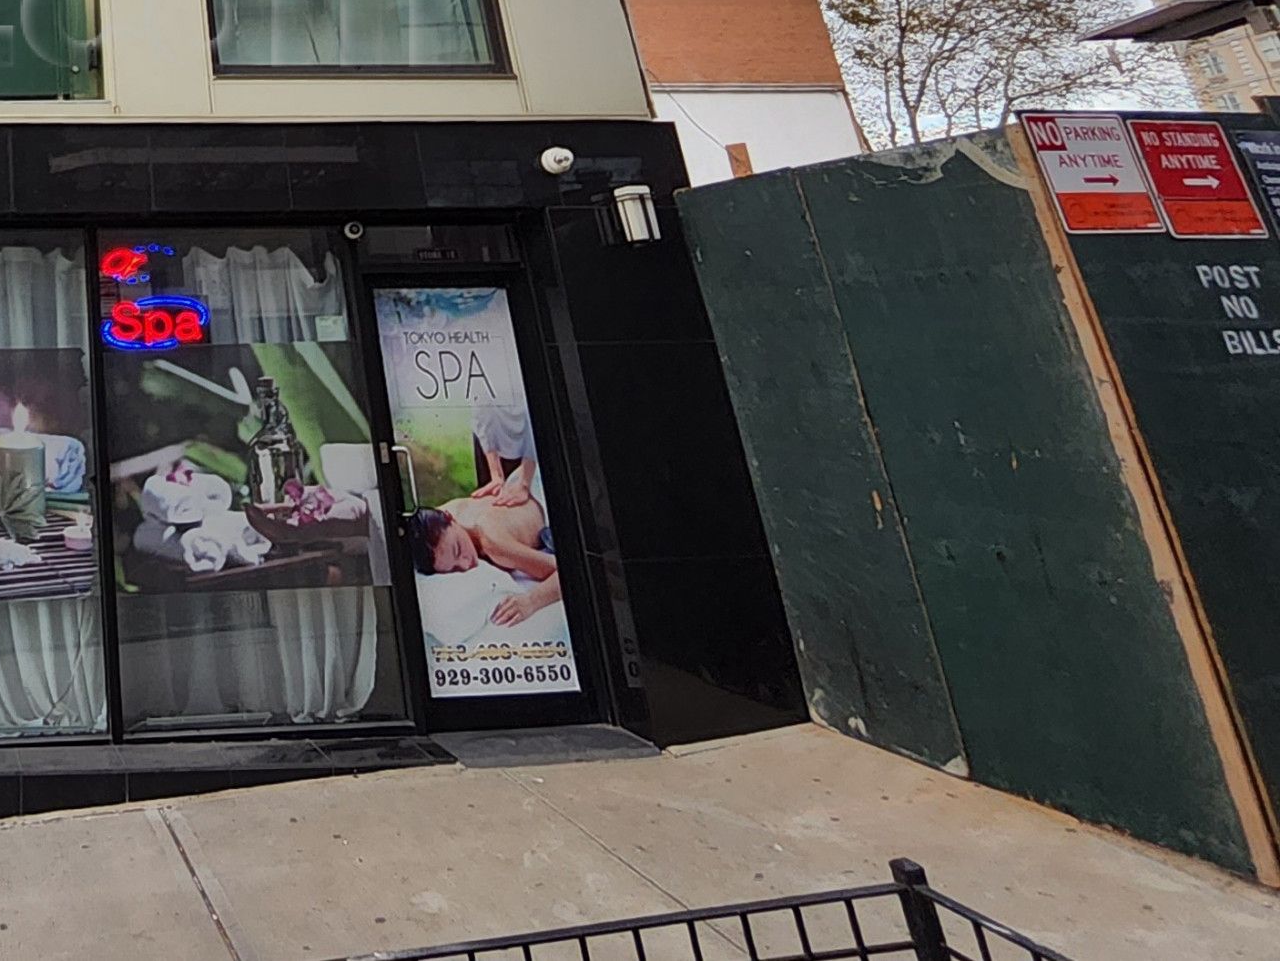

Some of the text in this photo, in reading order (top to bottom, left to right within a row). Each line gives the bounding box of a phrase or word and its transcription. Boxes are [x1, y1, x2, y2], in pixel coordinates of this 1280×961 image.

[1029, 121, 1120, 146] NO PARKING
[1140, 130, 1219, 147] NO STANDING
[1058, 154, 1123, 168] ANYTIME
[1160, 154, 1222, 169] ANYTIME
[1195, 265, 1261, 289] POST
[1220, 295, 1259, 319] NO
[111, 300, 203, 345] Spa
[402, 331, 490, 345] TOKYO HEALTH
[415, 350, 496, 400] SPA
[434, 664, 571, 687] 929-300-6550
